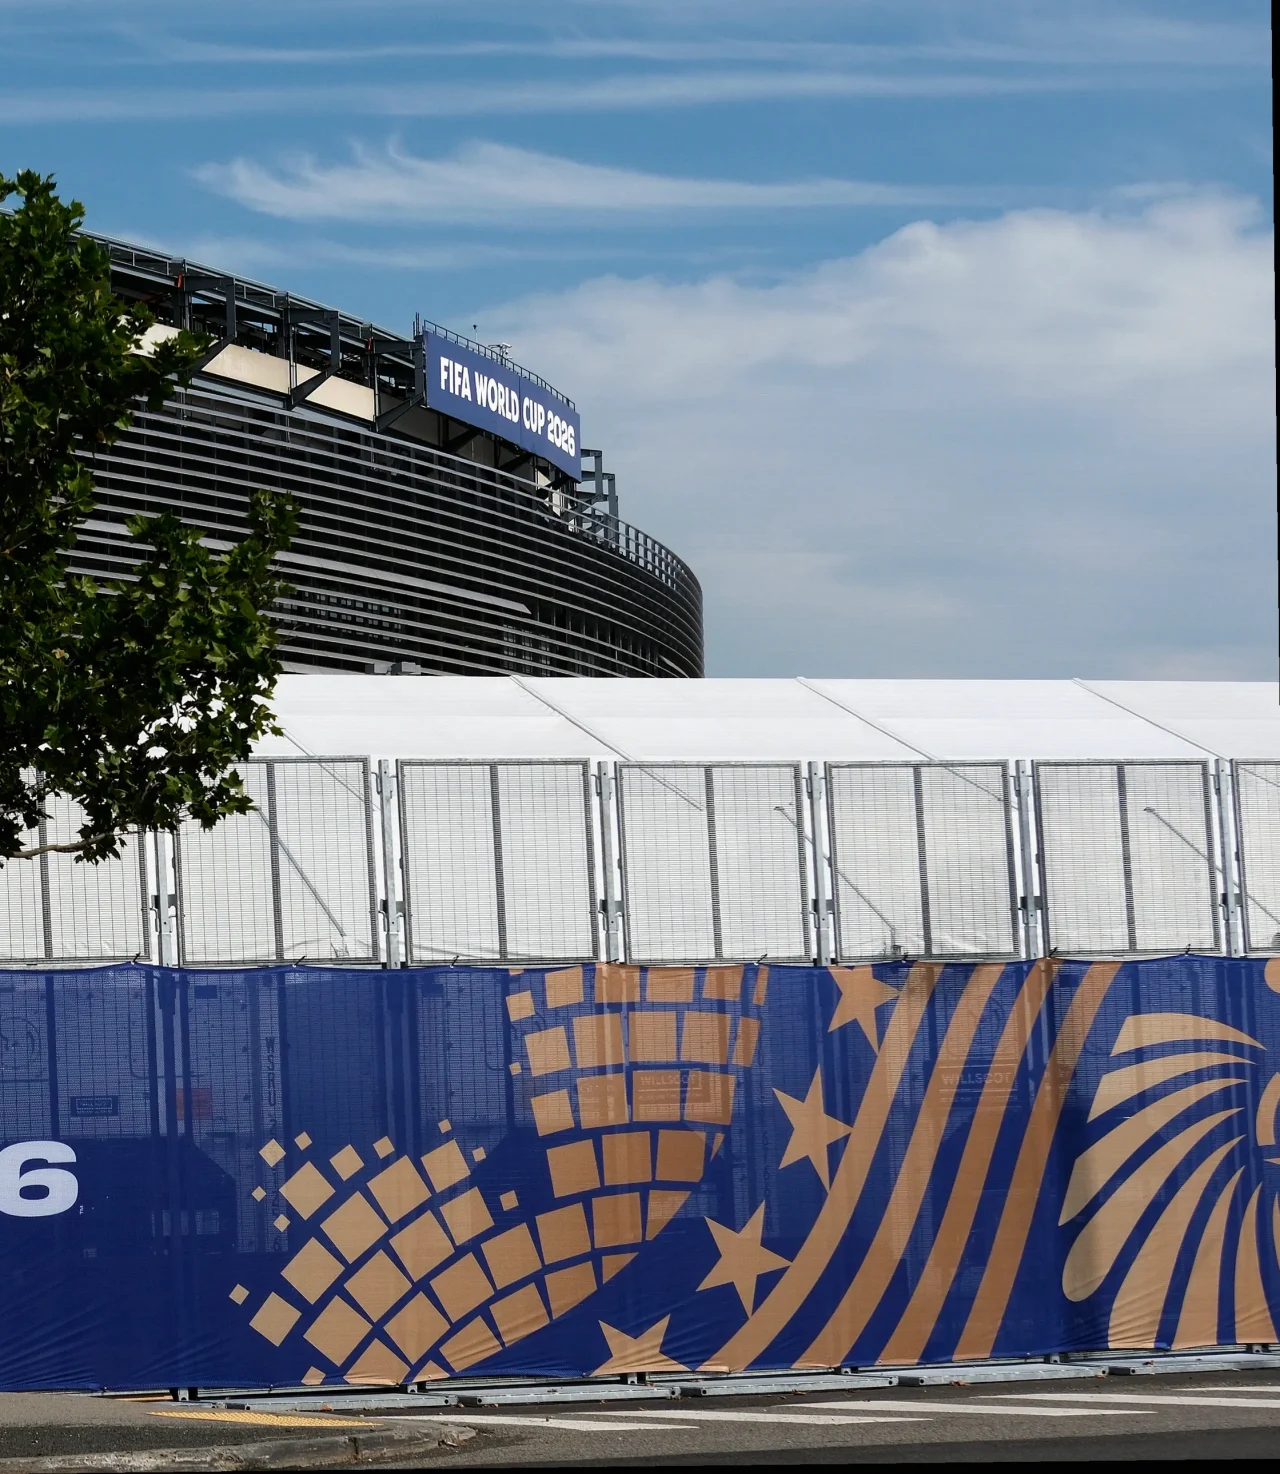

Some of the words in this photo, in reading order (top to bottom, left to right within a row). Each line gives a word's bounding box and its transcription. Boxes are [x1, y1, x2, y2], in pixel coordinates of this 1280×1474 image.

[440, 356, 472, 402] FIFA
[475, 371, 520, 423] WORLD
[522, 396, 546, 436] CUP
[547, 409, 576, 457] 2026
